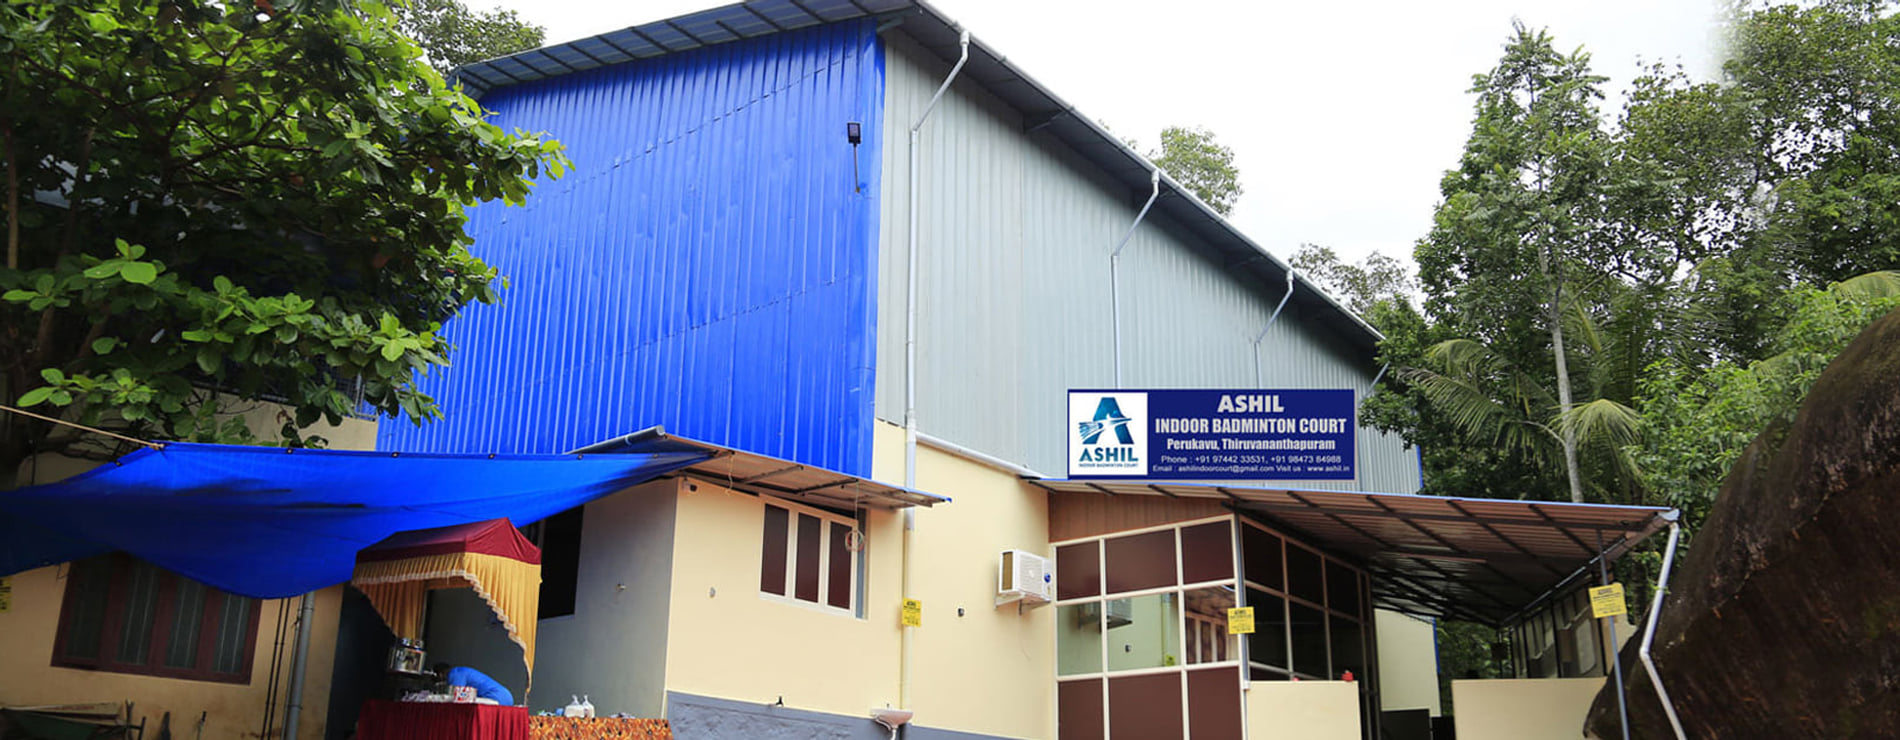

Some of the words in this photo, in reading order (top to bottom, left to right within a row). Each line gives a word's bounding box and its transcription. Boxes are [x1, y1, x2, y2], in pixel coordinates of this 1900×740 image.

[1217, 394, 1285, 413] ASHIL
[1155, 418, 1209, 434] INDOOR
[1212, 418, 1296, 434] BADMINTON
[1299, 418, 1347, 434] COURT
[1166, 438, 1220, 451] Perukavu,
[1221, 438, 1336, 452] Thiruvananthapuram
[1079, 447, 1139, 462] ASHIL
[1161, 455, 1188, 463] Phone
[1195, 455, 1210, 463] +91
